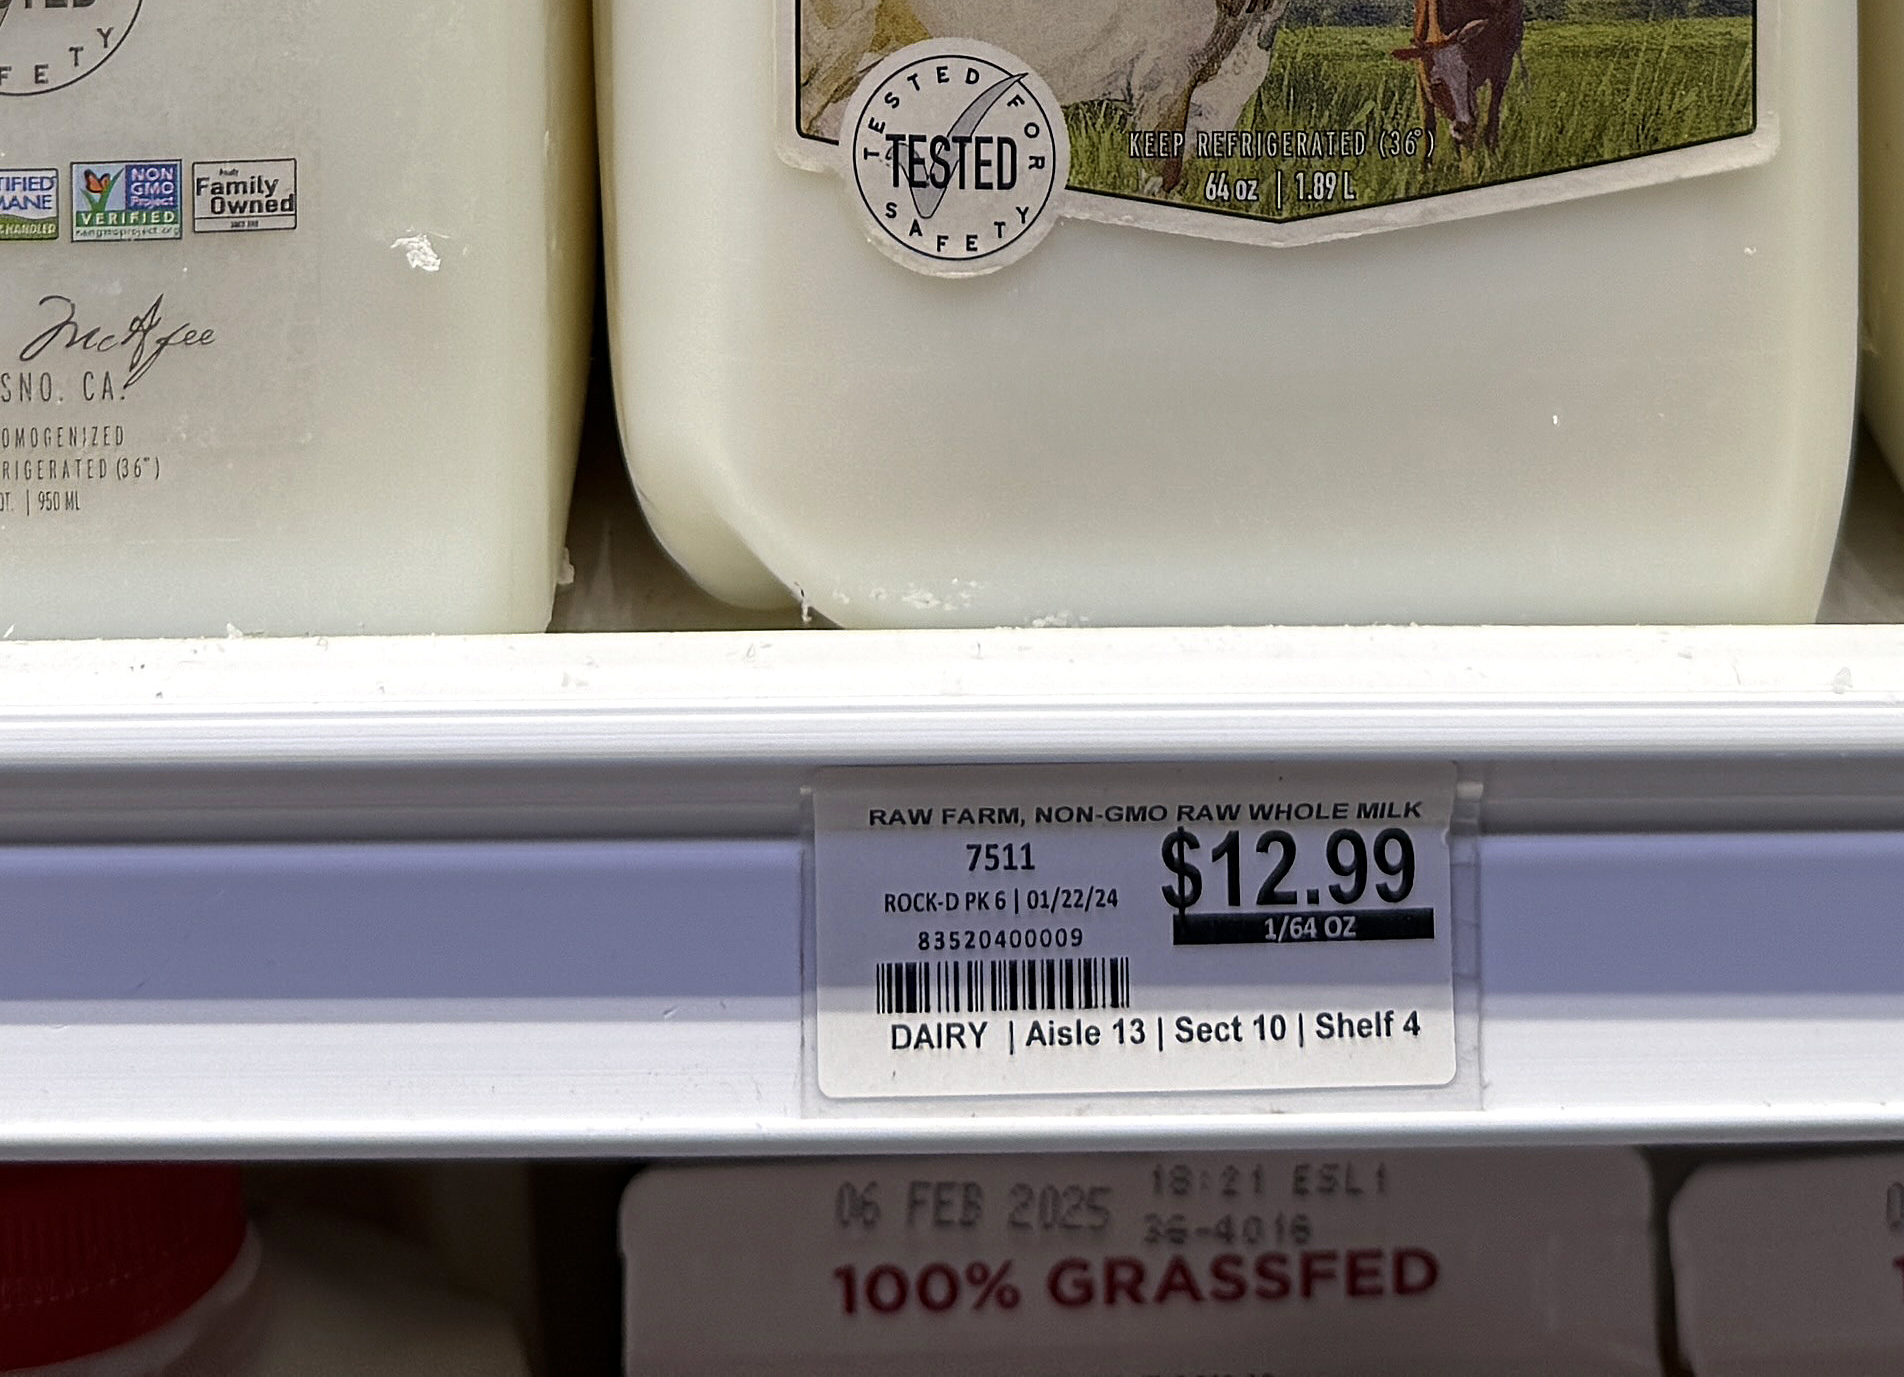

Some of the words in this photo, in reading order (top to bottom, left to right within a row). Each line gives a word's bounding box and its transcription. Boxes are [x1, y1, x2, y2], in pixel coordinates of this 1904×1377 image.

[1129, 132, 1184, 157] KEEP
[1196, 131, 1366, 158] REFRIGERATED
[885, 134, 1017, 190] TESTED
[196, 176, 278, 200] Family
[1204, 173, 1229, 201] 64
[1236, 178, 1258, 200] oz
[1296, 171, 1335, 200] 1.89
[1344, 171, 1356, 200] L
[210, 193, 294, 215] Owned
[869, 808, 933, 826] RAW
[941, 807, 1026, 828] FARM,
[1035, 805, 1167, 824] NON-GMO
[1176, 804, 1240, 821] RAW
[1247, 803, 1348, 821] WHOLE
[1356, 801, 1422, 819] MILK
[966, 843, 1035, 871] 7511
[1161, 827, 1415, 915] $12.99
[884, 891, 959, 913] ROCK-D
[1027, 888, 1118, 910] 01/22/24
[917, 928, 1082, 950] 83520400009
[1264, 918, 1316, 941] 1/64
[1324, 916, 1356, 939] OZ
[891, 1022, 987, 1050] DAIRY
[1026, 1022, 1100, 1047] Aisle
[1112, 1021, 1145, 1045] 13
[1174, 1017, 1243, 1044] Sect
[1253, 1015, 1286, 1041] 10
[1315, 1012, 1395, 1039] Shelf
[1404, 1012, 1420, 1038] 4
[836, 1182, 880, 1229] 06
[906, 1180, 983, 1228] FEB
[1008, 1185, 1112, 1231] 2025
[834, 1260, 1021, 1315] 100%
[1046, 1246, 1439, 1314] GRASSFED
